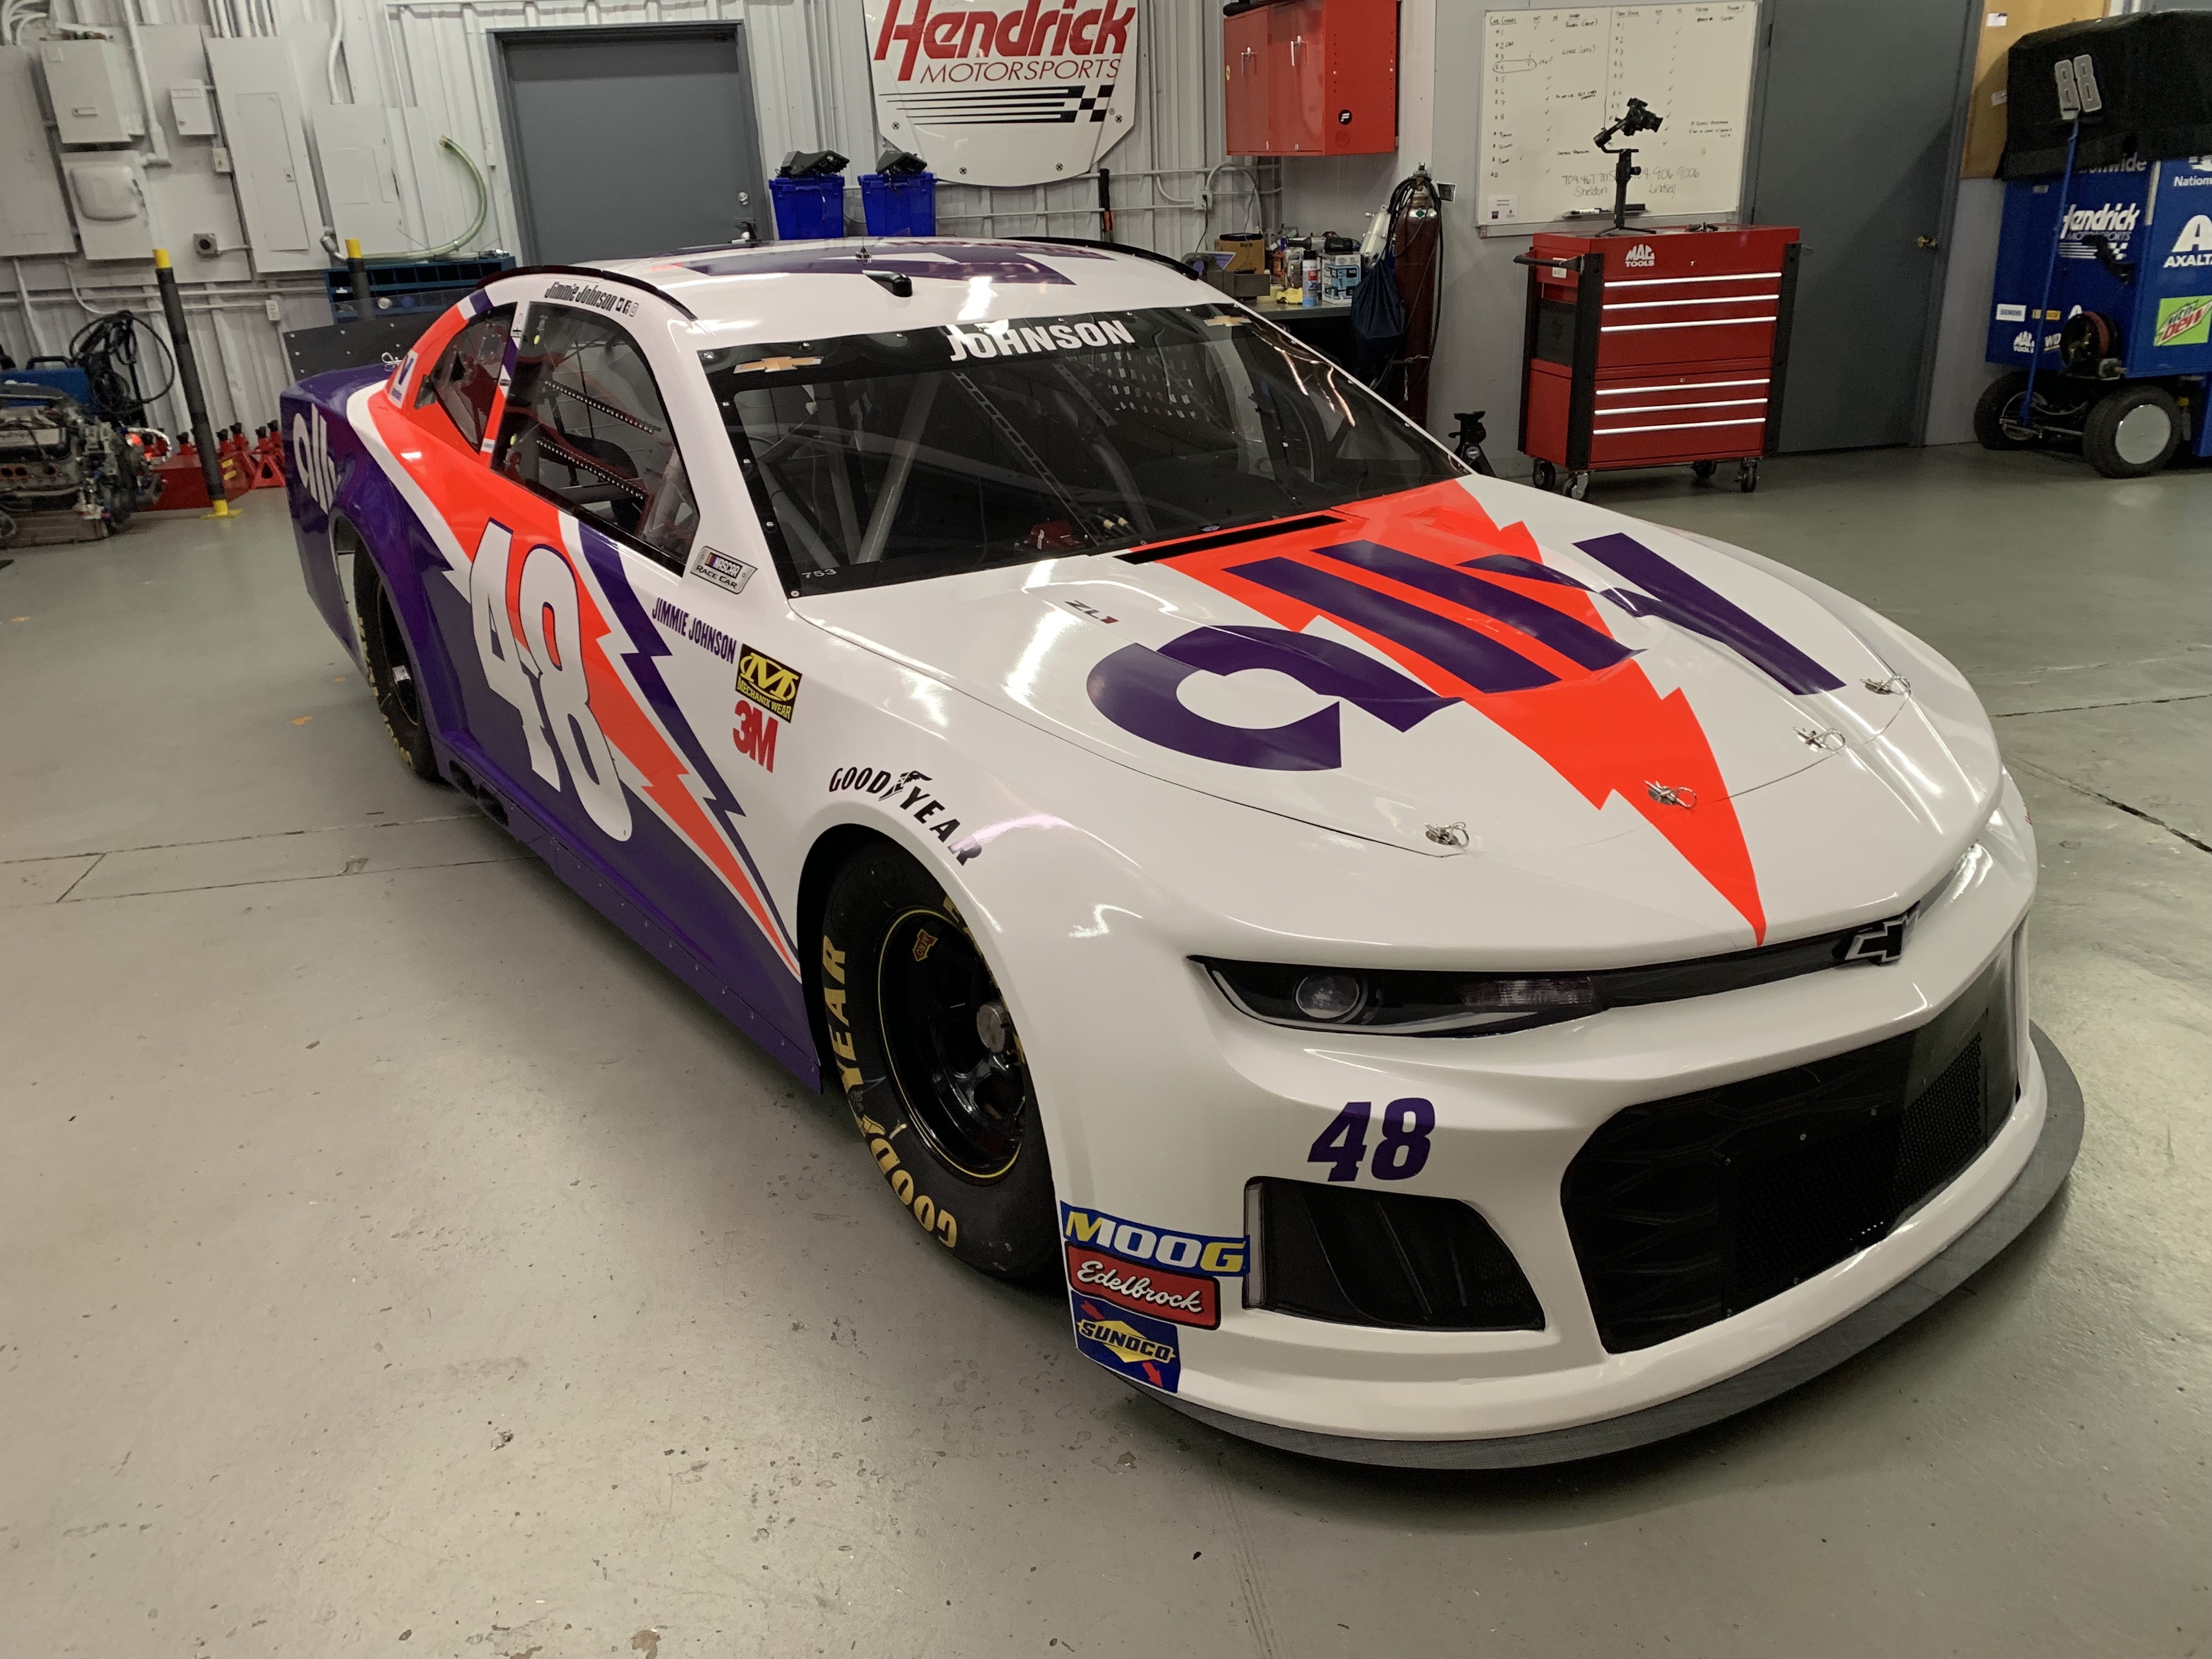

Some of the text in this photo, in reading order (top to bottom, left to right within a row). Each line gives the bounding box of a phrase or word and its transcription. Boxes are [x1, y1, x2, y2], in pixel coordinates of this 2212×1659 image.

[874, 0, 1136, 81] Hendrick
[919, 59, 1121, 84] MOTORSPORTS
[1624, 259, 1655, 268] TOOLS
[1626, 244, 1655, 261] MAC
[2163, 254, 2212, 268] AXALT
[946, 320, 1136, 362] JOHNSON
[696, 565, 737, 589] RACE CAR
[713, 556, 741, 579] NASCAR
[801, 568, 837, 579] 753
[652, 597, 737, 665] JIMMIE JOHNSON
[470, 517, 633, 842] 48
[737, 676, 792, 720] MECHANIX WEAR
[733, 699, 778, 774] 3M
[916, 934, 929, 956] AERO
[1307, 1097, 1436, 1182] 48
[1065, 1210, 1246, 1273] MOOG
[1077, 1260, 1202, 1313] Edelbrock
[1081, 1322, 1170, 1361] SUNOCO
